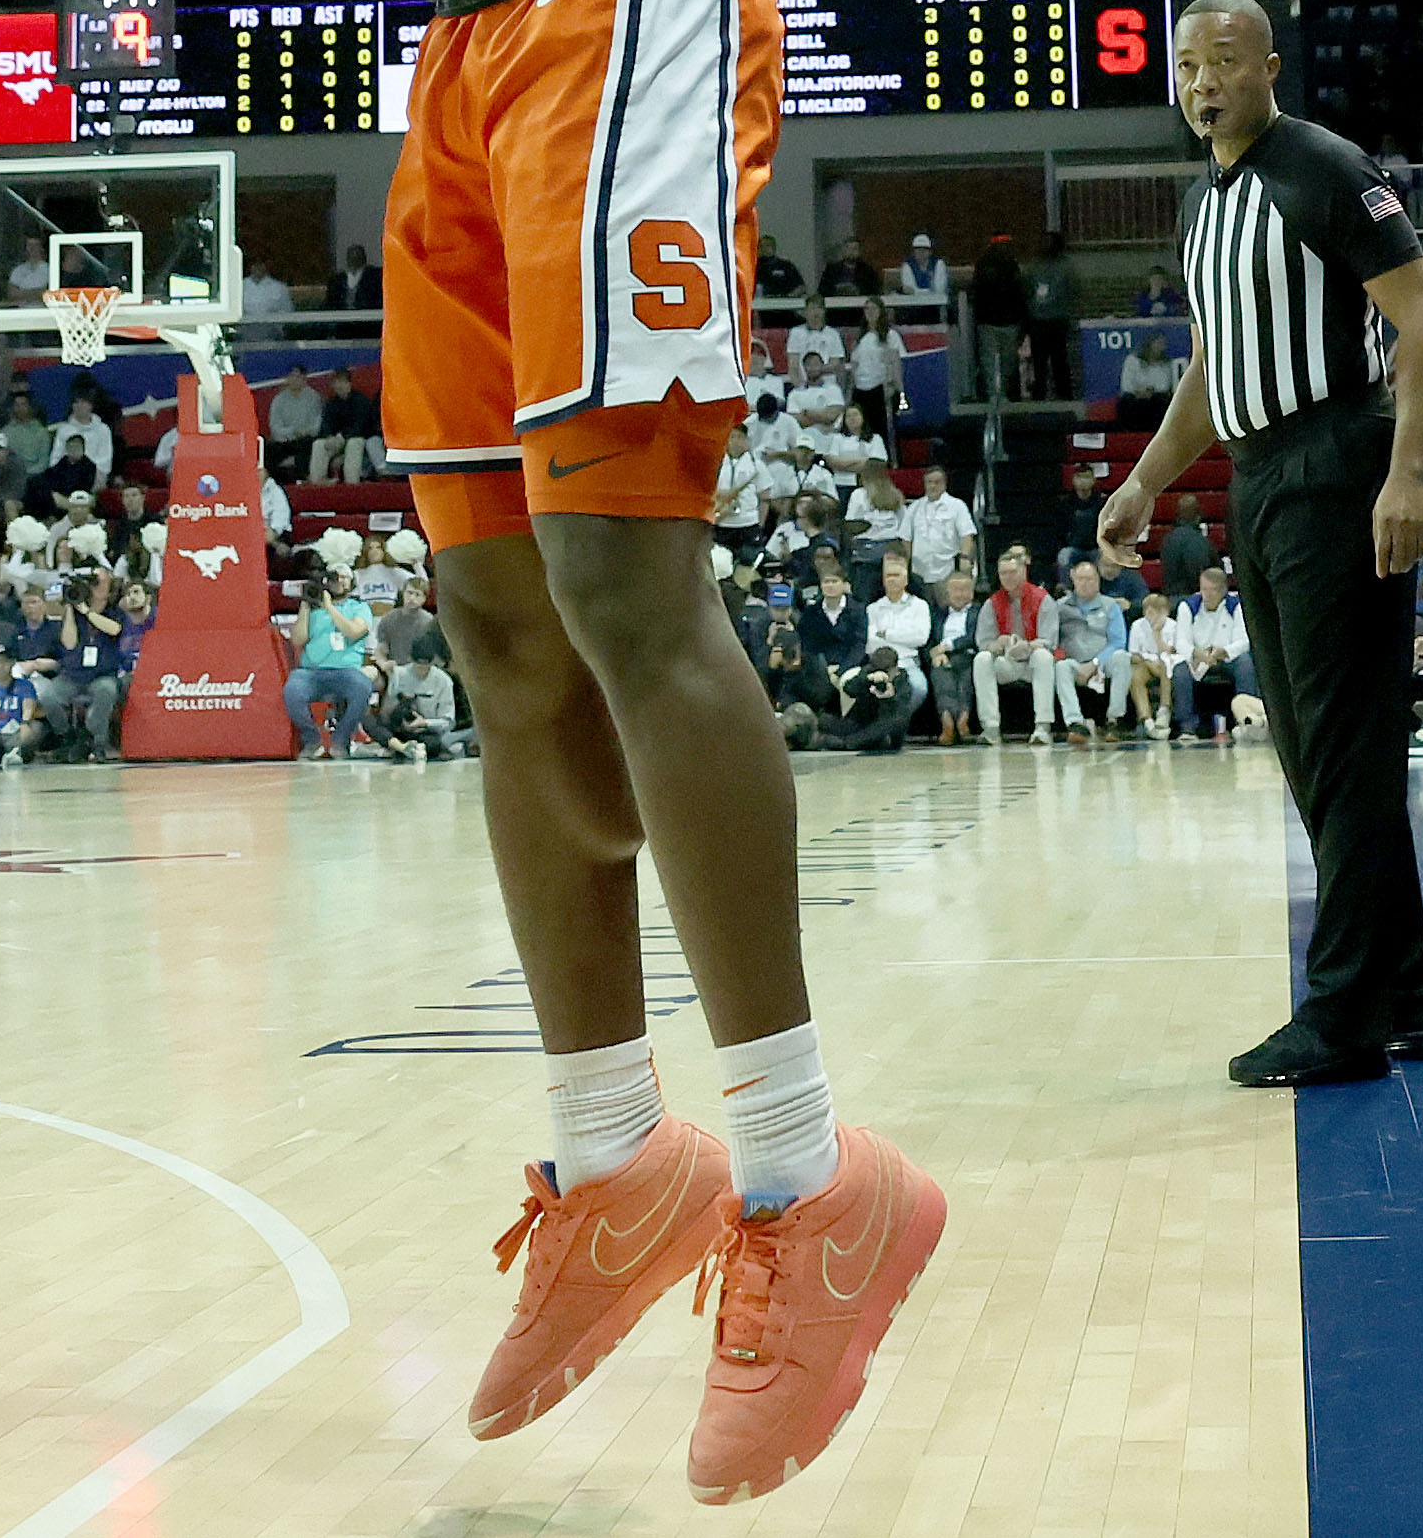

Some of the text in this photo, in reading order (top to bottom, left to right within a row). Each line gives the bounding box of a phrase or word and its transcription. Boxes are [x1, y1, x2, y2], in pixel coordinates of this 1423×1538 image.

[230, 4, 374, 28] PTS REB AST PF
[786, 2, 1062, 28] CUFFE 3 1 0 0
[114, 10, 151, 63] 9
[237, 31, 251, 48] 0
[280, 29, 291, 47] 1
[323, 28, 336, 46] 0
[358, 27, 371, 44] 0
[786, 24, 1063, 50] BELL 0 0 0 0
[1096, 7, 1146, 74] S
[238, 49, 371, 70] 2 0 1 0
[787, 46, 1063, 71] CARLOS 2 0 3 0
[238, 69, 369, 90] 6 1 0 1
[788, 67, 1064, 92] MAJSTOROVIC 0 0 0 0
[238, 94, 250, 112] 2
[281, 93, 292, 111] 1
[324, 92, 334, 109] 1
[359, 91, 371, 108] 0
[798, 97, 866, 114] MCLEOD
[927, 93, 940, 110] 0
[971, 91, 985, 109] 0
[1015, 90, 1029, 107] 0
[1051, 89, 1065, 106] 0
[237, 116, 251, 133] 0
[281, 115, 293, 132] 0
[324, 113, 335, 131] 1
[358, 112, 371, 130] 0
[629, 219, 713, 331] S
[1097, 331, 1133, 350] 101
[169, 502, 248, 522] Origin Bank
[157, 672, 256, 698] Boulevard
[164, 698, 242, 711] COLLECTIVE
